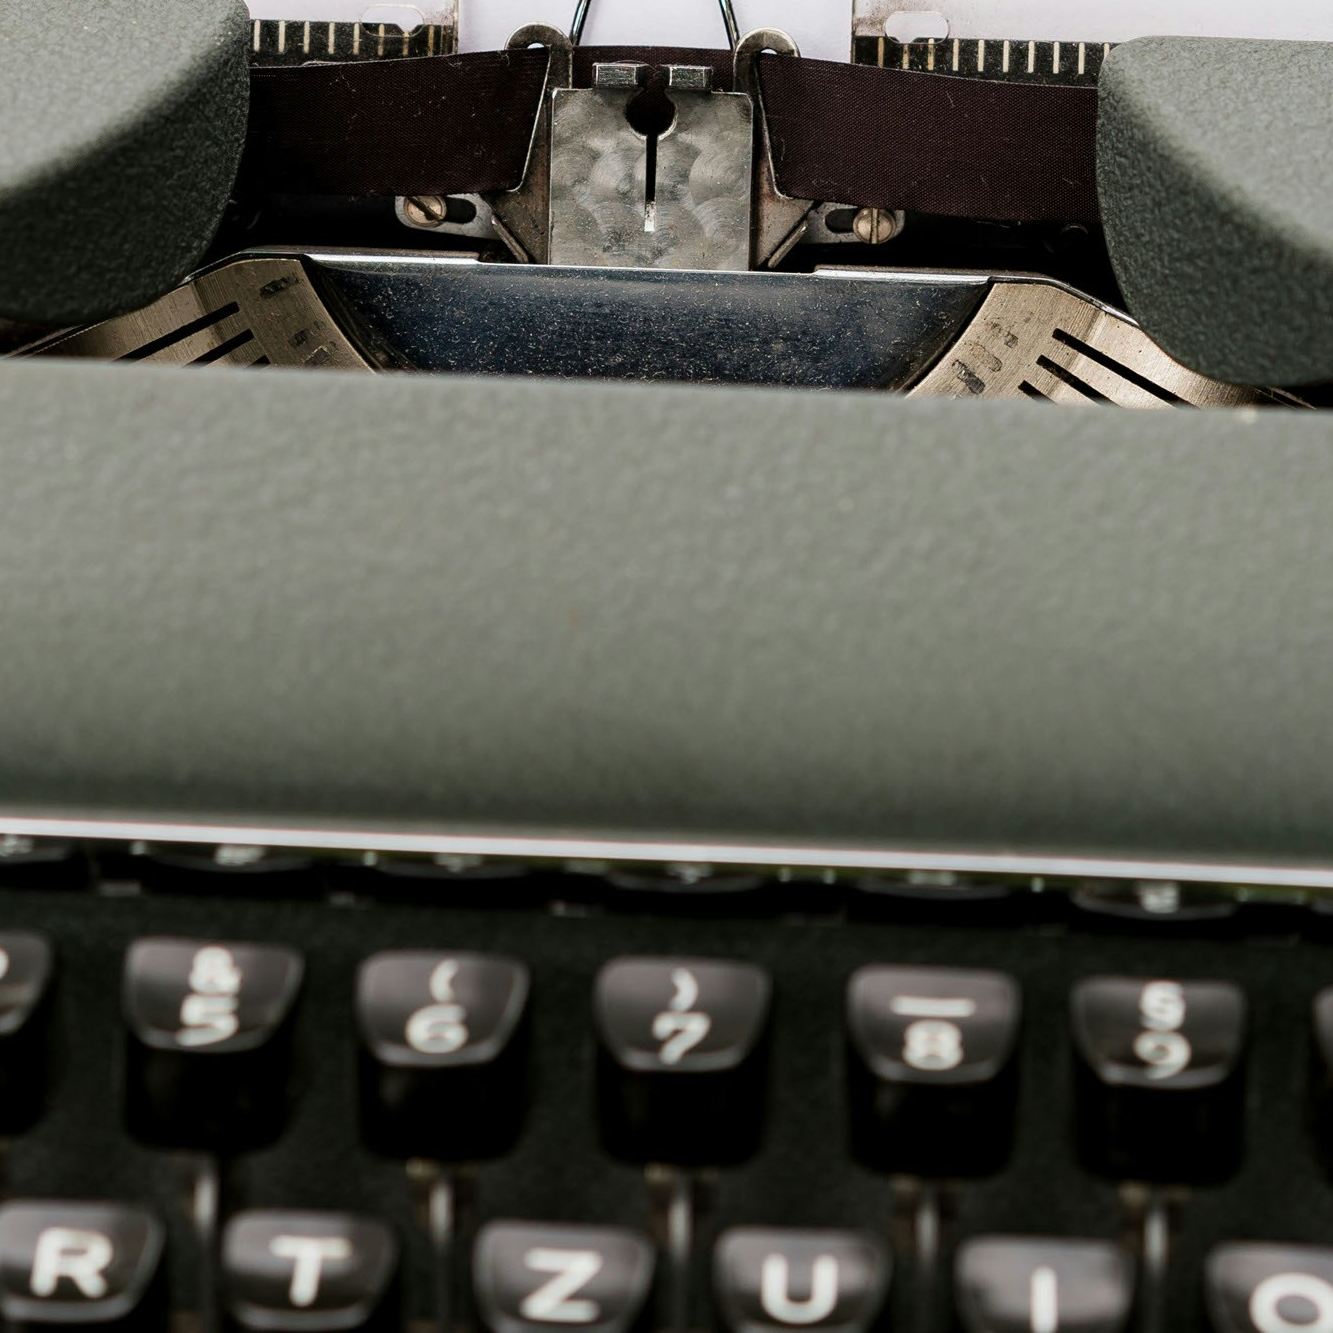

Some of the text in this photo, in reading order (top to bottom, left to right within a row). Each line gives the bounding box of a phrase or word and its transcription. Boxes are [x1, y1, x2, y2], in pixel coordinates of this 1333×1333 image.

[176, 993, 239, 1047] 5
[405, 1002, 468, 1055] 6
[652, 1010, 712, 1064] 7
[903, 1019, 964, 1071] 8
[1134, 1031, 1192, 1080] 9
[29, 1224, 115, 1299] R
[267, 1232, 353, 1307] T
[520, 1246, 605, 1324] Z
[759, 1251, 840, 1325] U
[1028, 1263, 1060, 1333] I
